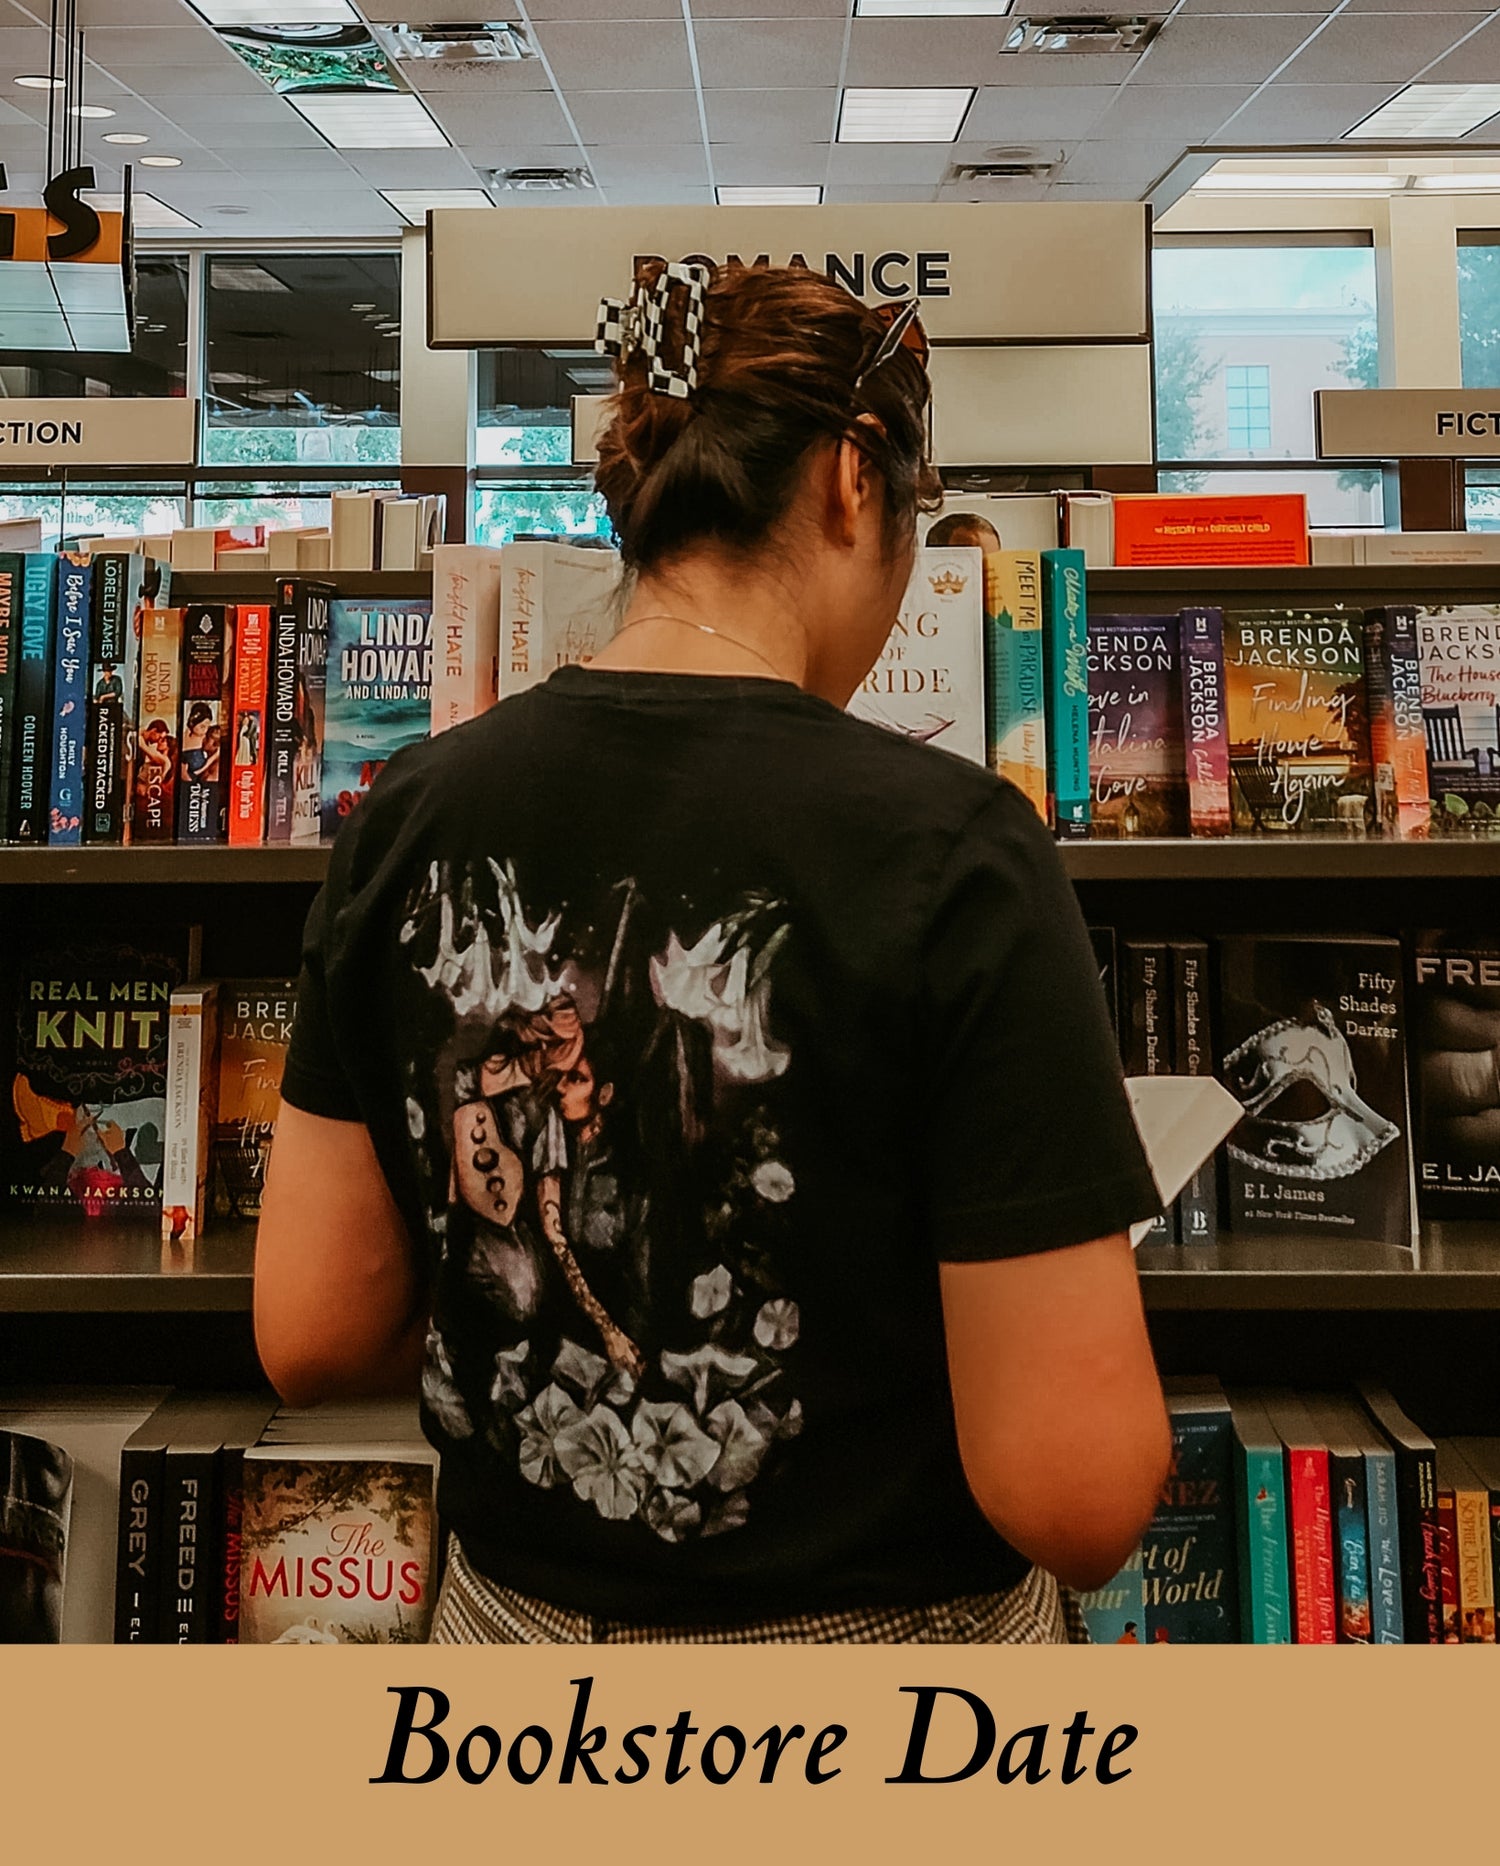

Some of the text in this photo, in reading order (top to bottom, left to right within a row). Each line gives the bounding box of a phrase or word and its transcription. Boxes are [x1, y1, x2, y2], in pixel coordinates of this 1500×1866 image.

[65, 574, 84, 614] Before
[1016, 560, 1035, 600] MEET
[22, 565, 48, 661] UGLY LOVE
[101, 559, 117, 659] LORELEI JAMES
[1018, 607, 1035, 628] ME
[62, 627, 82, 656] Saw
[278, 614, 297, 658] LINDA
[446, 624, 463, 678] HATE
[511, 619, 531, 674] HATE
[1240, 627, 1355, 647] BRENDA
[1419, 643, 1500, 662] JACKS
[1421, 625, 1500, 643] BREN
[61, 657, 80, 684] You
[1063, 642, 1089, 698] Wish
[1233, 646, 1361, 667] JACKSON
[1425, 664, 1454, 684] The
[145, 652, 158, 714] HOWARD
[159, 661, 171, 703] LINDA
[238, 657, 251, 705] HOWELL
[275, 659, 296, 724] HOWARD
[346, 685, 370, 700] AND
[374, 685, 409, 700] LINDA
[1018, 644, 1037, 715] PARADISE
[1128, 684, 1149, 705] in
[1189, 655, 1206, 744] JACKSON
[1391, 654, 1409, 742] JACKSON
[1405, 659, 1423, 738] BRENDA
[1420, 684, 1497, 708] Blueberry
[1203, 661, 1220, 740] BRENDA
[1251, 669, 1356, 743] Finding
[20, 715, 36, 810] COLLEEN HOOVER
[58, 727, 68, 779] HOUGHTON
[67, 739, 77, 766] EMILY
[95, 708, 109, 809] RACKED STACKED
[277, 750, 289, 777] KILL
[1252, 722, 1324, 767] Home
[1072, 746, 1081, 792] HUNTING
[1096, 764, 1148, 804] Cove
[148, 765, 162, 828] ESCAPE
[188, 782, 201, 833] DUCHESS
[236, 770, 254, 820] Only for You
[275, 796, 288, 826] TELL
[1269, 760, 1346, 825] Again
[30, 981, 169, 1001] REAL MEN
[1142, 956, 1157, 986] Fifty
[1358, 972, 1396, 994] Fifty
[237, 1001, 297, 1019] BRE
[1145, 988, 1159, 1034] Shades
[1183, 959, 1201, 1052] Fifty Shades of
[1339, 994, 1397, 1015] Shades
[36, 1010, 160, 1049] KNIT
[1345, 1020, 1399, 1039] Darker
[174, 1041, 185, 1129] BRENDA JACKSON
[9, 1184, 72, 1197] KWANA
[1244, 1183, 1326, 1202] E L James
[1422, 1163, 1439, 1180] E
[1447, 1164, 1463, 1181] L
[1376, 1461, 1388, 1502] SARAH
[128, 1479, 149, 1577] GREY
[1261, 1491, 1278, 1530] The
[1313, 1507, 1330, 1554] Happy
[179, 1479, 198, 1591] FREED
[326, 1521, 387, 1558] The
[1163, 1535, 1198, 1576] of
[1459, 1499, 1480, 1603] SOPHIE JORDAN
[224, 1531, 242, 1621] MISSUS
[249, 1554, 422, 1605] MISSUS
[1262, 1536, 1282, 1597] Friend
[1317, 1556, 1331, 1588] Ever
[1379, 1566, 1398, 1606] Love
[1141, 1568, 1225, 1607] World
[1313, 1595, 1332, 1627] After
